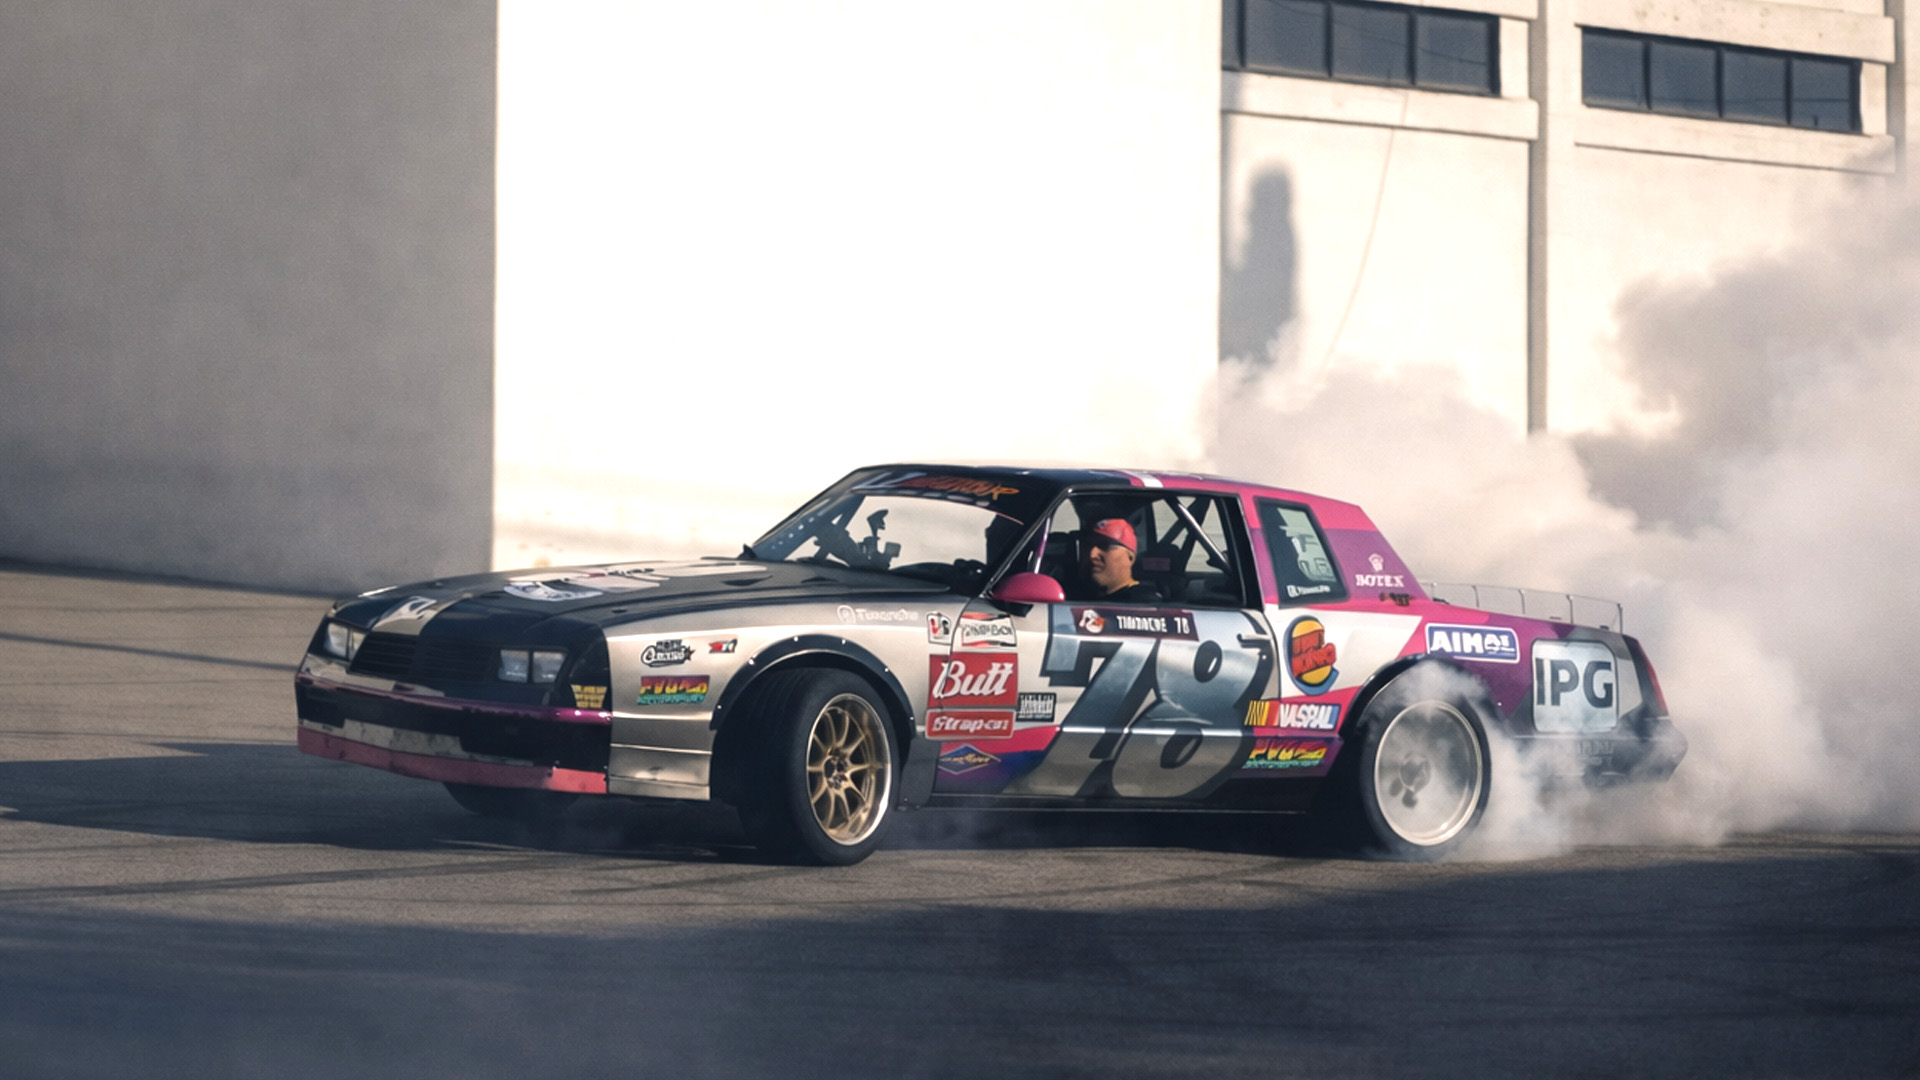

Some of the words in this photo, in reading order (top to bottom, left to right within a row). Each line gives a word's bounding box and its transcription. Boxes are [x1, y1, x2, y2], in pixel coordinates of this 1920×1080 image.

[932, 661, 1014, 699] Butt
[1003, 607, 1273, 798] 78
[1535, 658, 1614, 708] IPG
